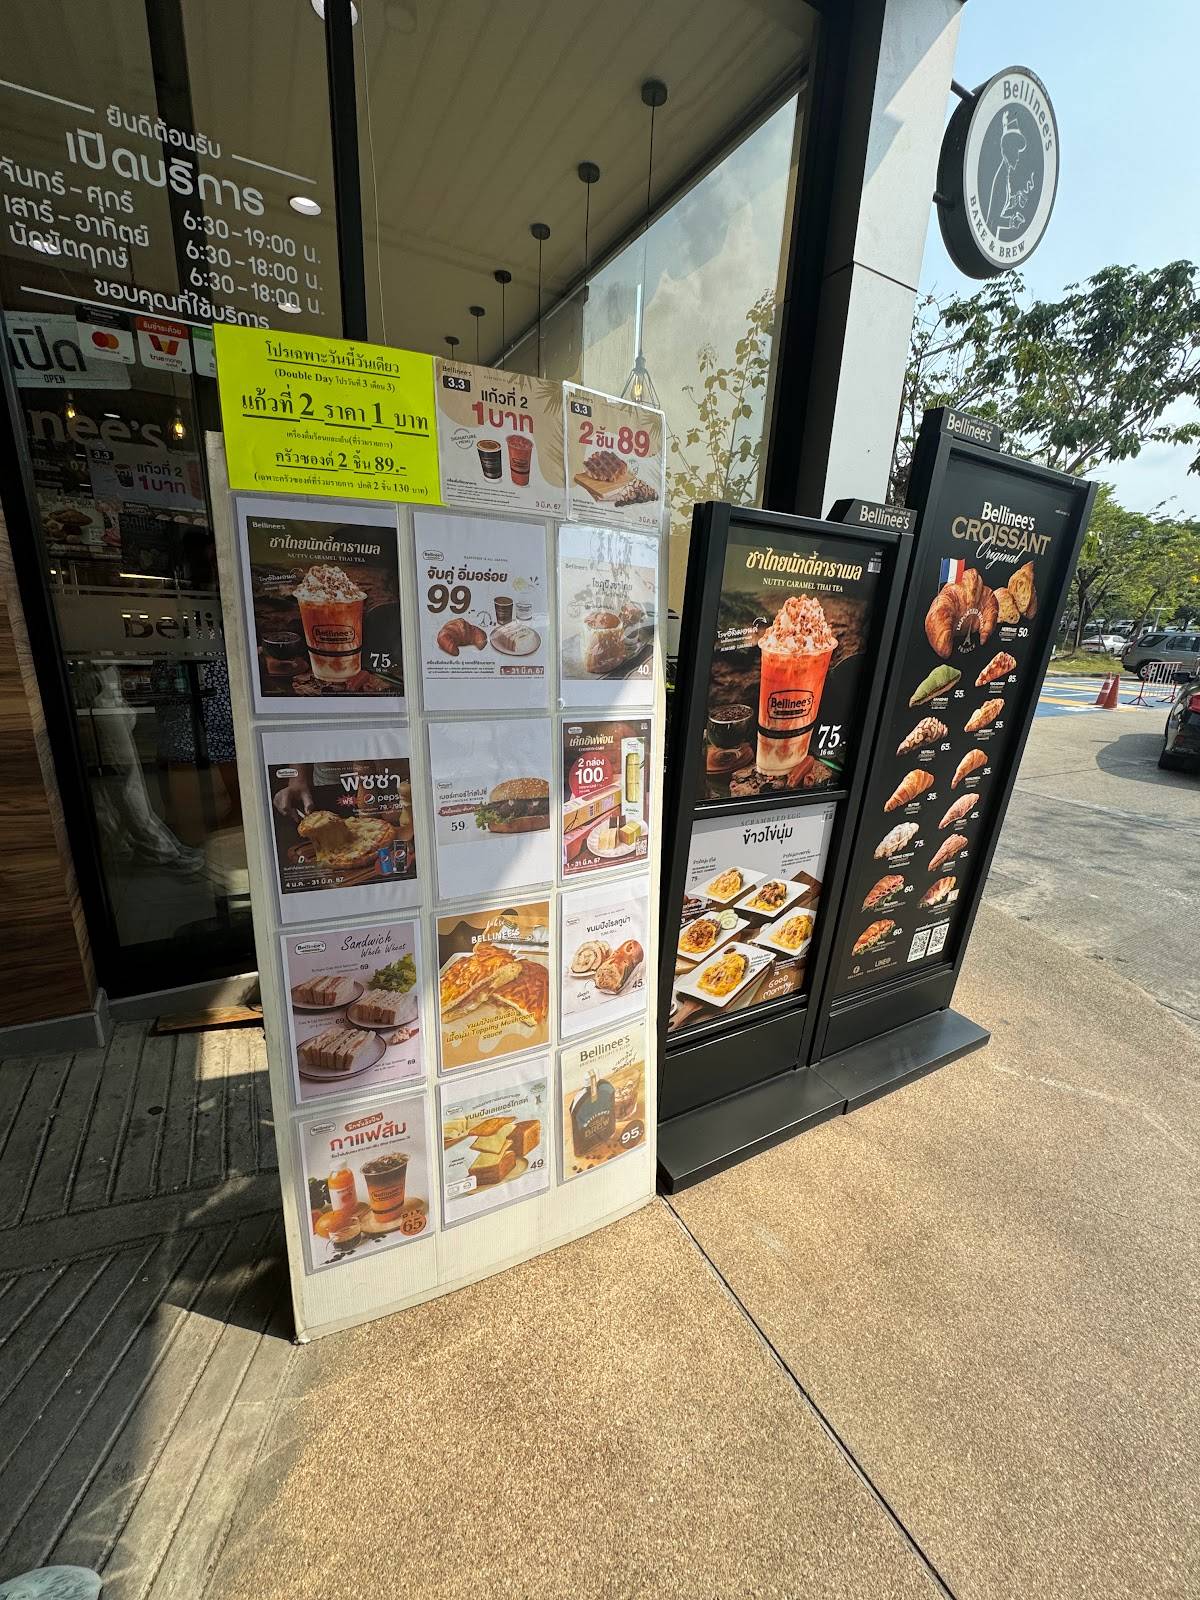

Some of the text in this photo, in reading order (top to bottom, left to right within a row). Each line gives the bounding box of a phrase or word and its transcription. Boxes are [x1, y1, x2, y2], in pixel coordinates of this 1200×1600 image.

[106, 104, 222, 159] ยินดีต้อนรับ
[65, 127, 266, 216] เปิดบริการ
[970, 195, 1026, 258] BAKE & BREW
[94, 278, 270, 330] ขอบคุณที่ใช้บริการ
[266, 340, 400, 374] โปรเฉพาะวันนี้วันเดียว
[43, 374, 65, 384] OPEN
[275, 368, 312, 381] (Double
[315, 373, 333, 385] Day
[362, 379, 368, 388] 3
[387, 383, 396, 393] 3)
[447, 378, 466, 390] 3.3
[242, 384, 429, 431] แก้วที่ 2 ราคา 1 บาท
[481, 386, 528, 409] แก้วที่ 2
[574, 404, 588, 415] 3.3
[579, 421, 614, 449] 2 ชิ้น
[946, 413, 992, 444] Bellinee's
[175, 468, 182, 477] 2
[338, 452, 348, 468] 2
[353, 450, 371, 470] ชิ้น
[375, 456, 406, 474] 89.-
[373, 481, 379, 490] 2
[394, 483, 409, 493] 130
[860, 505, 910, 530] Bellinee's
[981, 501, 1035, 531] Bellinee's
[951, 516, 1052, 556] CROISSANT
[746, 547, 863, 581] ชาไทยนัทตี้คาราเมล
[975, 535, 1026, 570] Original
[427, 564, 508, 585] จับคู่ อิ่มอร่อย
[763, 578, 843, 593] NUTTY CARAMEL THAI TEA
[770, 696, 812, 710] Bellinee's
[578, 757, 605, 767] 2 กล่อง
[340, 768, 401, 792] พิซซ่า
[451, 821, 465, 832] 59
[743, 823, 793, 845] ข้าวไข่นุ่ม
[341, 931, 392, 951] Sandwich
[361, 944, 406, 958] Whole Wheat
[632, 979, 643, 990] 45
[472, 1012, 535, 1036] Topping Mushroom
[580, 1035, 630, 1061] Bellinee's
[330, 1120, 407, 1152] กาแฟส้ม
[530, 1159, 544, 1170] 49
